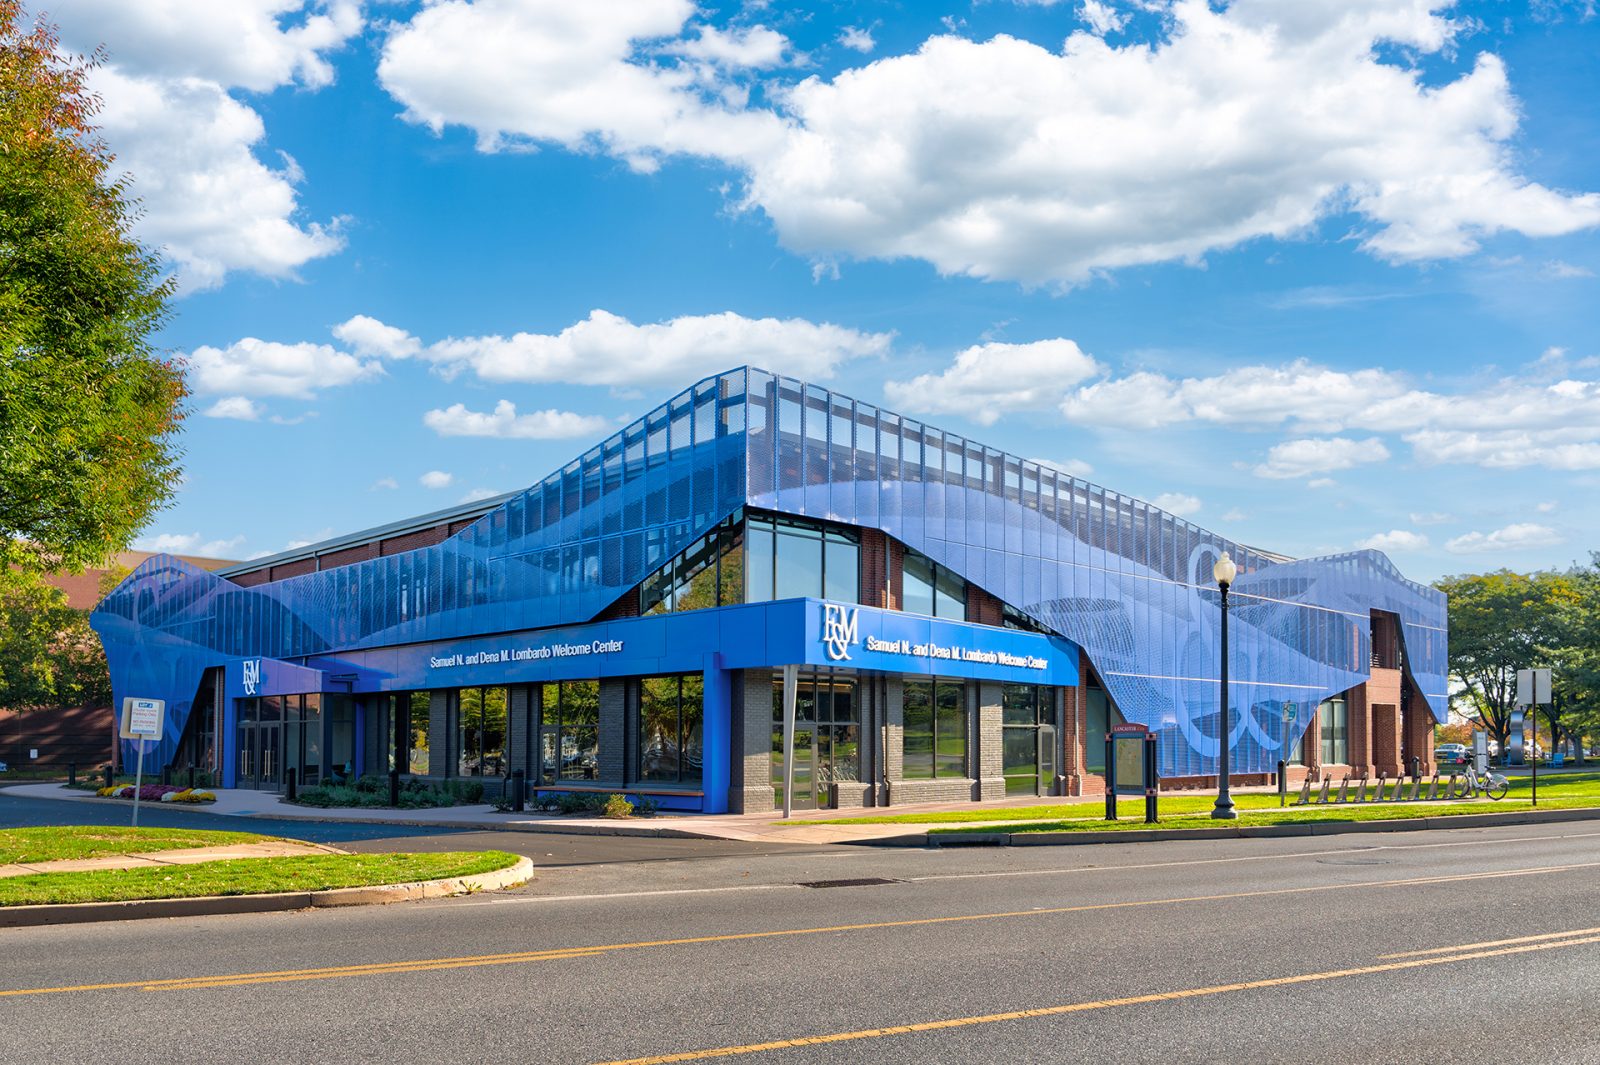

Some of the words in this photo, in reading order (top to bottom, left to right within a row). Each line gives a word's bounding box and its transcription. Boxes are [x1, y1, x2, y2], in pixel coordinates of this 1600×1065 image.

[430, 654, 456, 668] Samuel
[456, 654, 464, 666] N.
[466, 653, 479, 665] and
[480, 652, 499, 664] Dena
[501, 650, 509, 662] M.
[512, 646, 551, 660] Lombardo
[552, 643, 591, 657] Welcome
[592, 640, 623, 654] Center
[867, 636, 900, 651] Samuel
[902, 640, 911, 655] N.
[913, 643, 928, 656] and
[930, 644, 950, 659] Dena
[952, 646, 961, 660] M.
[963, 647, 997, 664] Lombardo
[998, 651, 1027, 667] Welcome
[1028, 655, 1048, 669] Center
